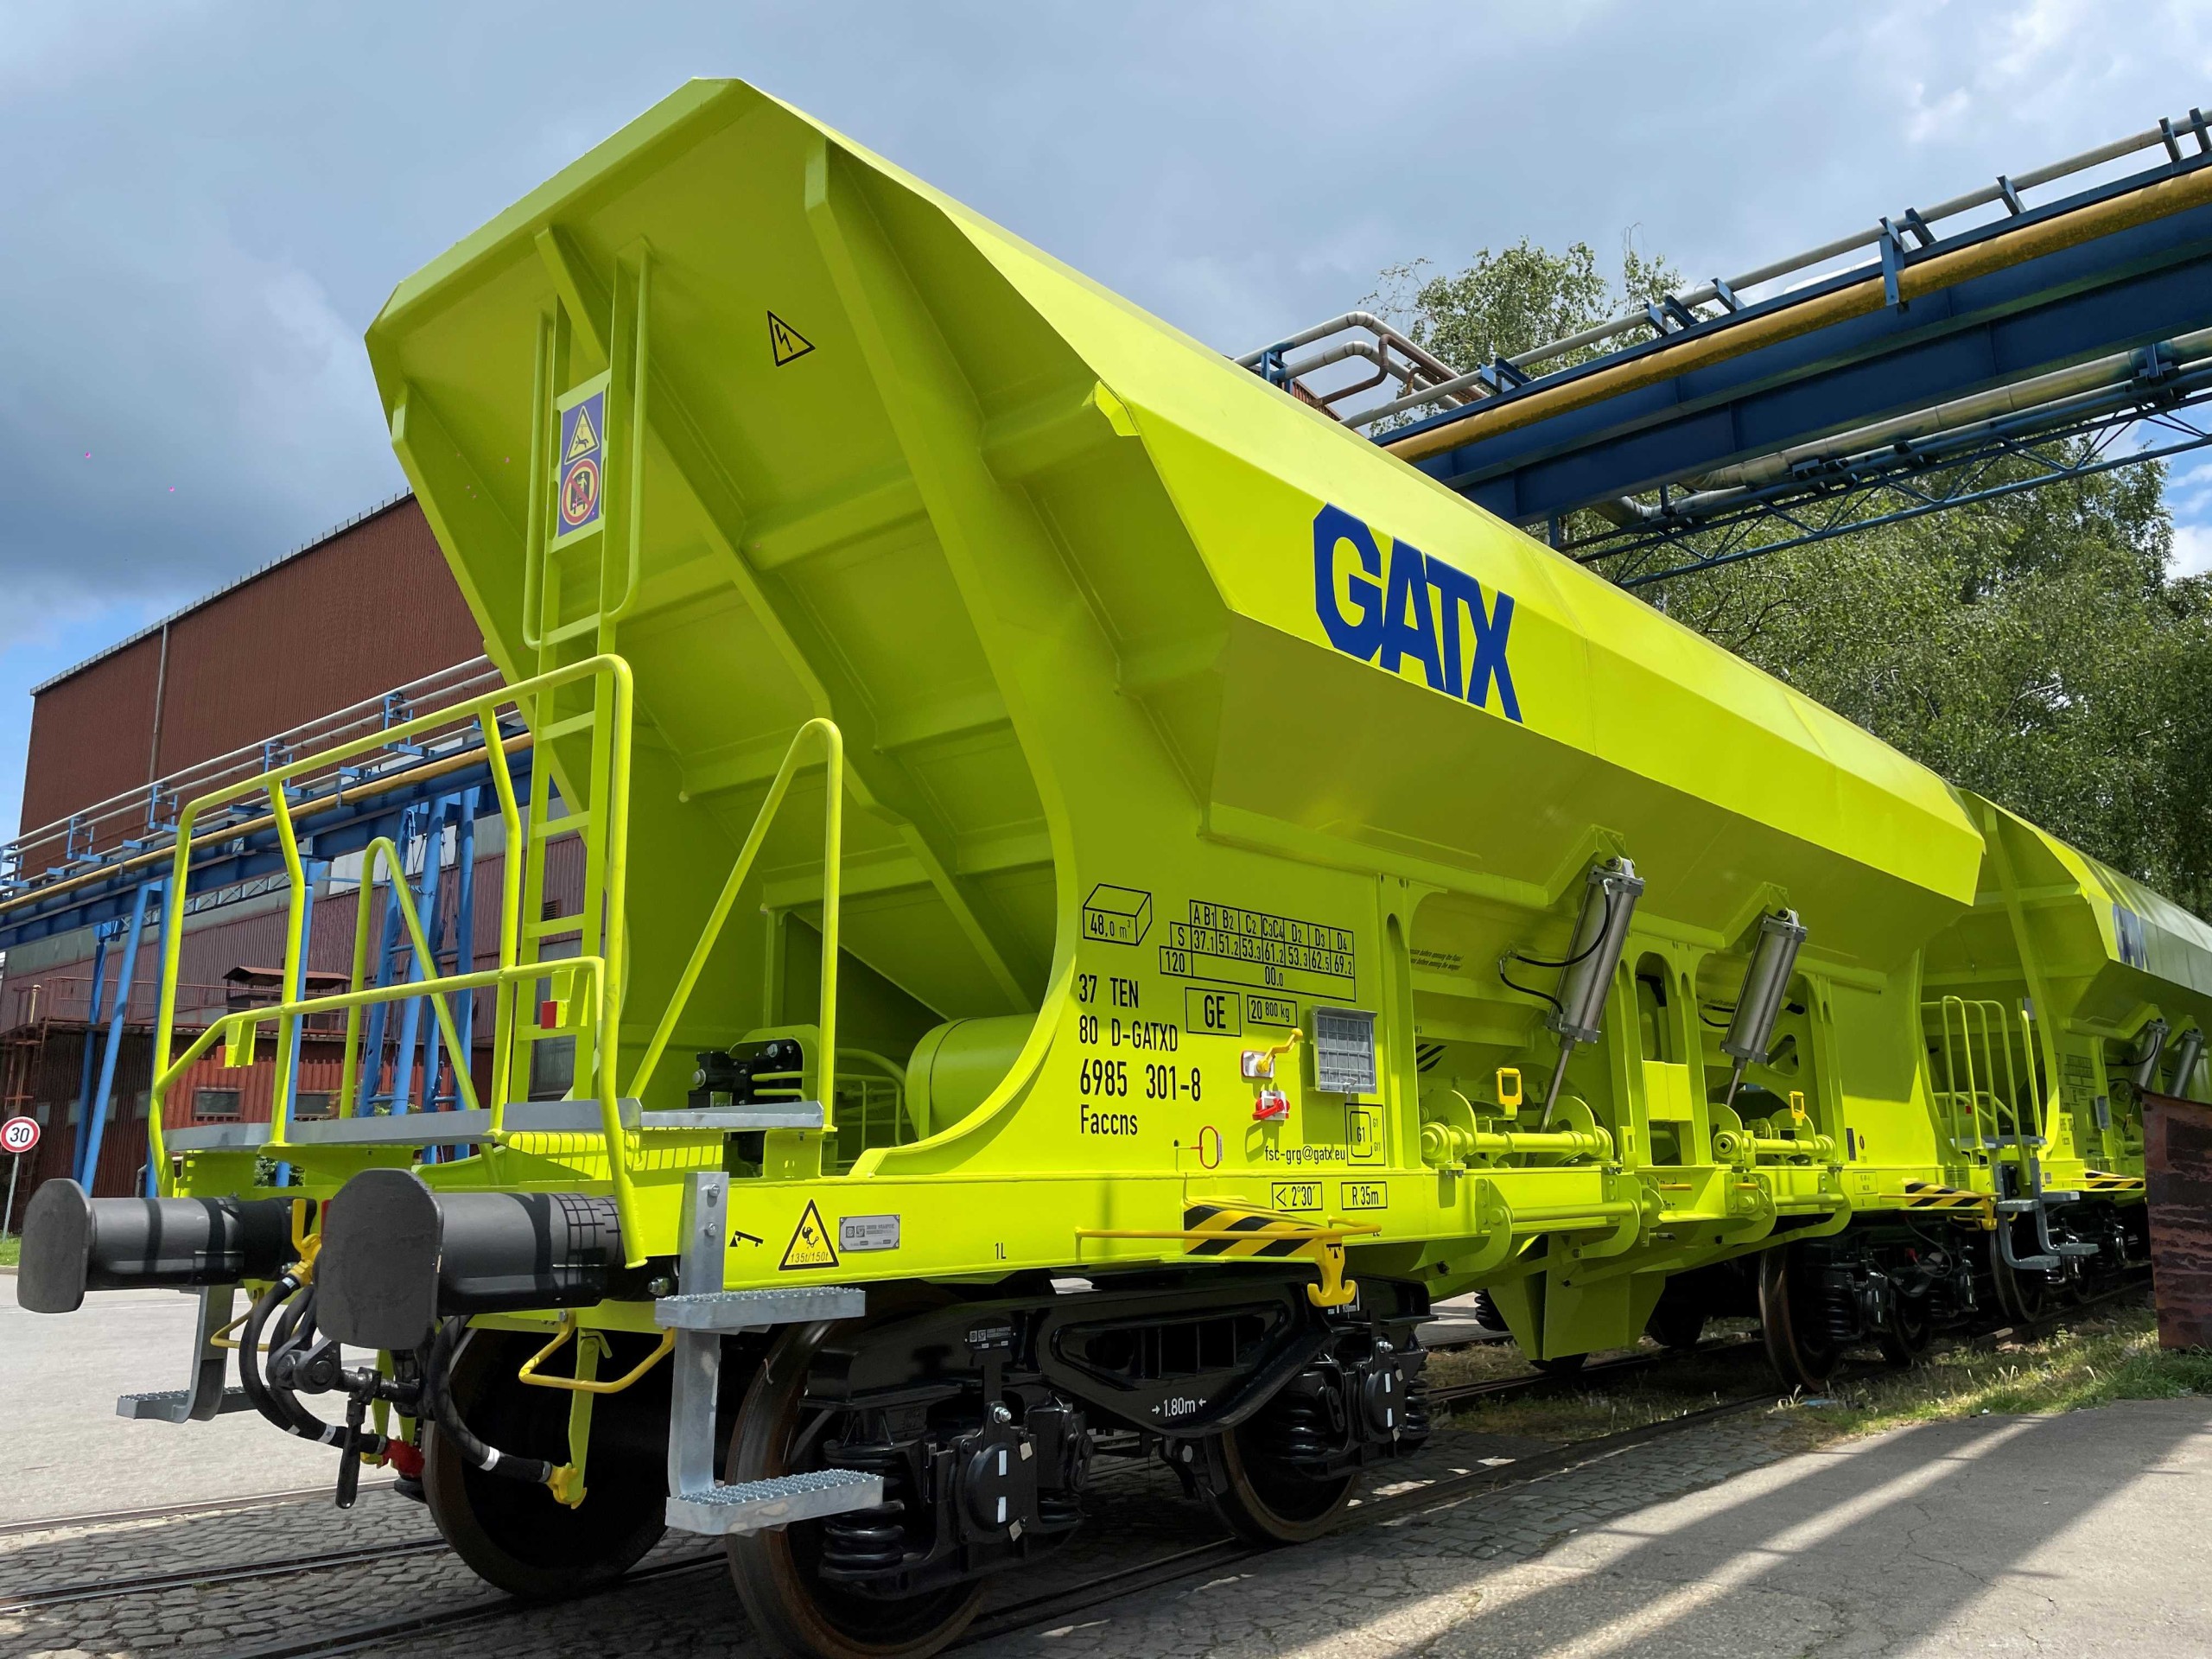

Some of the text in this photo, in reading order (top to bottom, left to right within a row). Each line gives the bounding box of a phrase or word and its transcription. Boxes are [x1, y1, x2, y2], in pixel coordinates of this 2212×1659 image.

[1313, 502, 1523, 723] GATX
[1090, 912, 1115, 937] 48,0
[1193, 905, 1201, 925] A
[1204, 906, 1215, 927] B1
[1223, 909, 1234, 930] B2
[1245, 914, 1256, 934] C2
[1291, 924, 1302, 944] D2
[1314, 928, 1325, 947] D3
[1337, 932, 1347, 950] D4
[1178, 926, 1352, 975] S 37.1 51.2 53.3 61.2 53.3 62.5 69.2
[1166, 950, 1283, 987] 120 00.0
[1079, 974, 1139, 1008] 37 TEN
[1205, 995, 1226, 1028] GE
[1251, 1000, 1290, 1022] 20 800 kg
[1079, 1014, 1178, 1052] 80 D-GATXD
[1080, 1058, 1201, 1102] 6985 301-8
[1081, 1104, 1138, 1135] Faccns
[10, 1127, 30, 1143] 30
[1357, 1127, 1365, 1142] G1
[1265, 1146, 1345, 1165] fsc-grg@gatx.eu
[1352, 1186, 1379, 1205] R 35m
[791, 1251, 829, 1263] 135t/150t
[995, 1243, 1007, 1260] 1L
[1163, 1397, 1196, 1417] 1.80m
